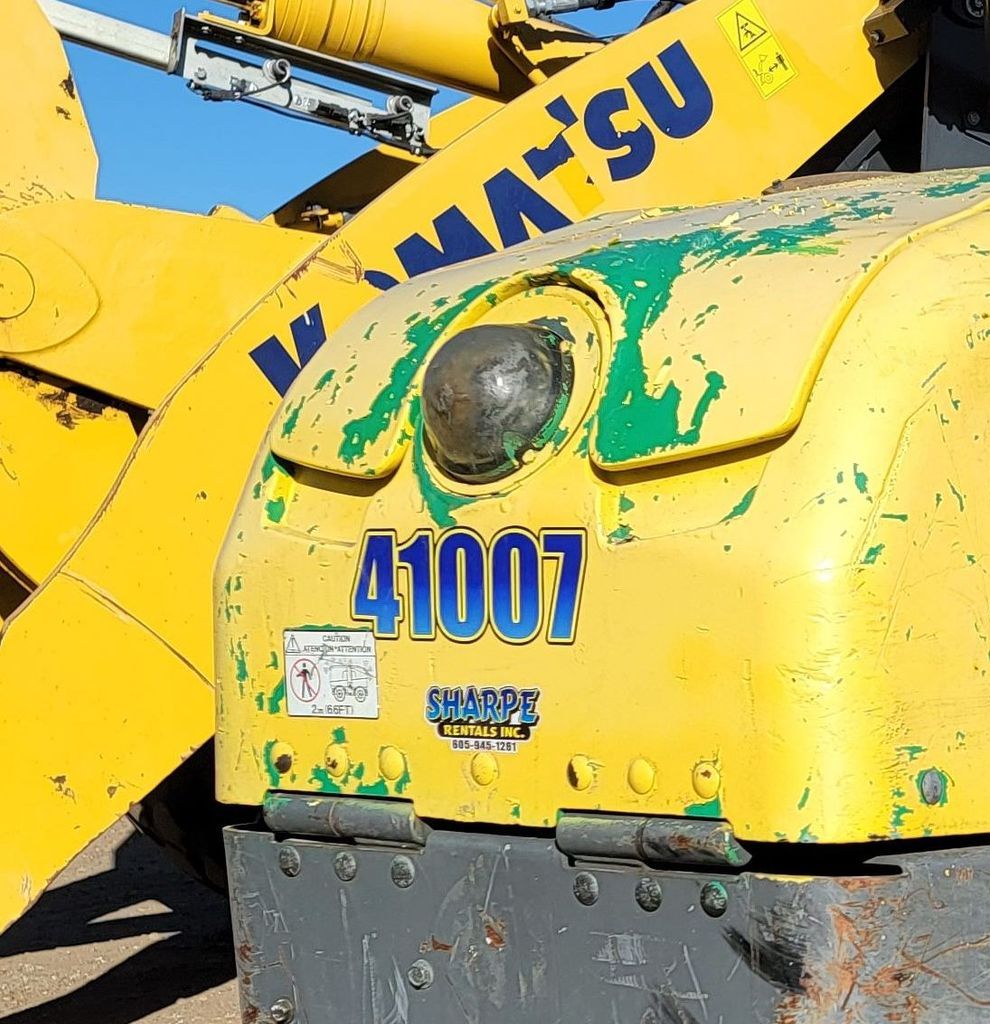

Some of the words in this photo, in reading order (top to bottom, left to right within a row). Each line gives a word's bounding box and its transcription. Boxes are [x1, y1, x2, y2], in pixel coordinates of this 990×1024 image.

[350, 526, 588, 645] 41007
[426, 686, 540, 726] SHARPE
[443, 724, 498, 737] RENTALS
[500, 726, 526, 739] INC.
[452, 740, 516, 751] 605-945-1261
